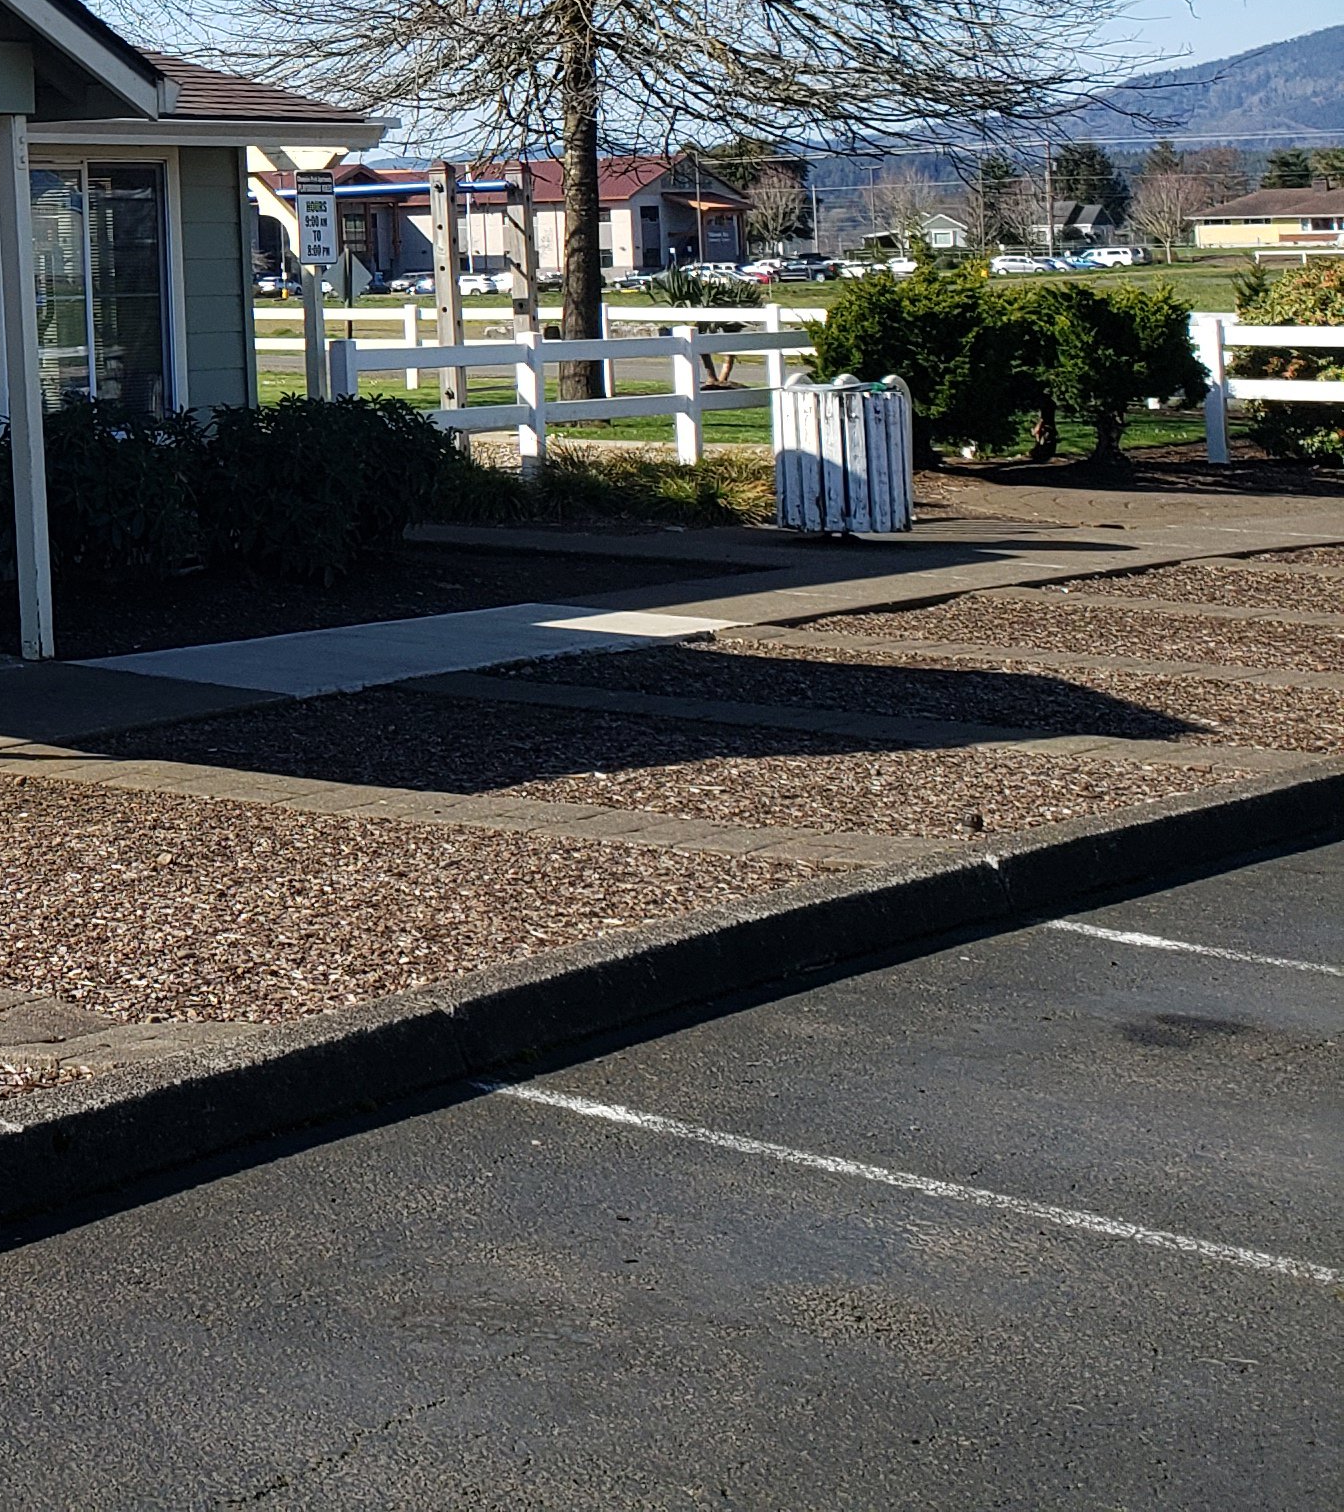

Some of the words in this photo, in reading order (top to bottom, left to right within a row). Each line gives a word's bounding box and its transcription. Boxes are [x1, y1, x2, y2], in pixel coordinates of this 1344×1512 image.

[306, 201, 327, 213] HOURS
[305, 215, 319, 228] 9:00
[320, 217, 328, 227] AM
[312, 230, 322, 242] TO
[307, 244, 321, 257] 8:00
[322, 246, 330, 257] PM
